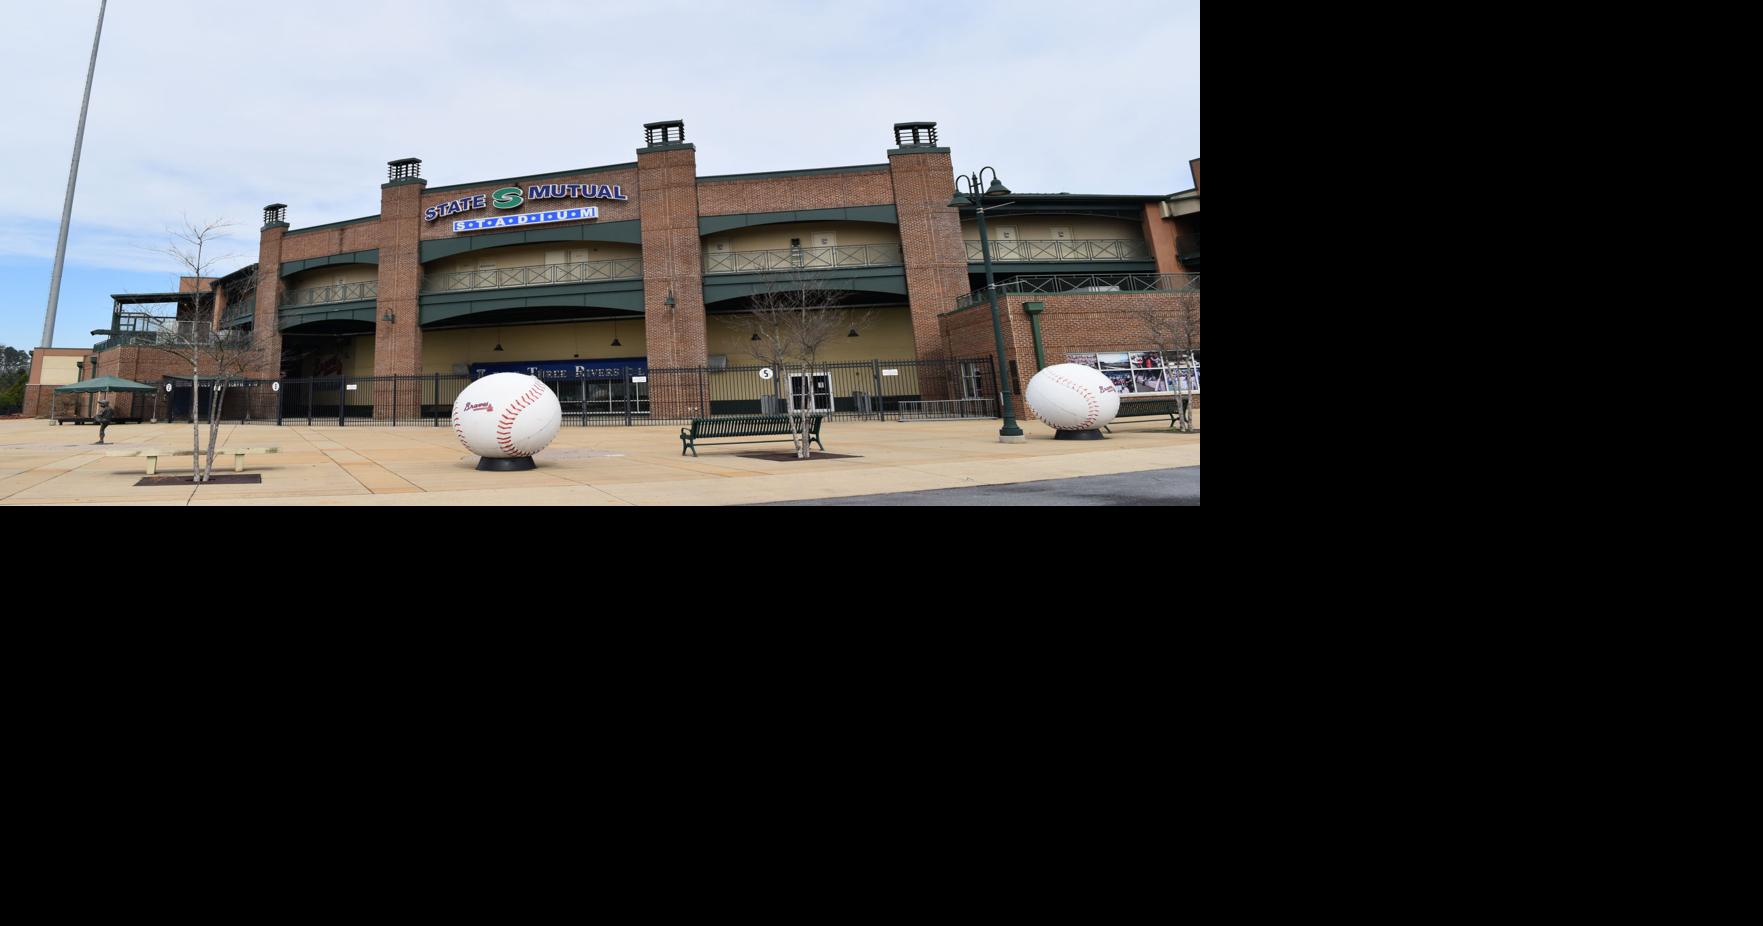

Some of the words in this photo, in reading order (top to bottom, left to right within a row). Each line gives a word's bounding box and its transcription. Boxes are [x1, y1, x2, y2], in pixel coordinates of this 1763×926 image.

[424, 193, 486, 222] STATE
[528, 184, 627, 200] MUTUAL
[456, 208, 596, 231] STADIUM
[576, 365, 620, 379] RIVERS
[464, 401, 489, 411] Braves
